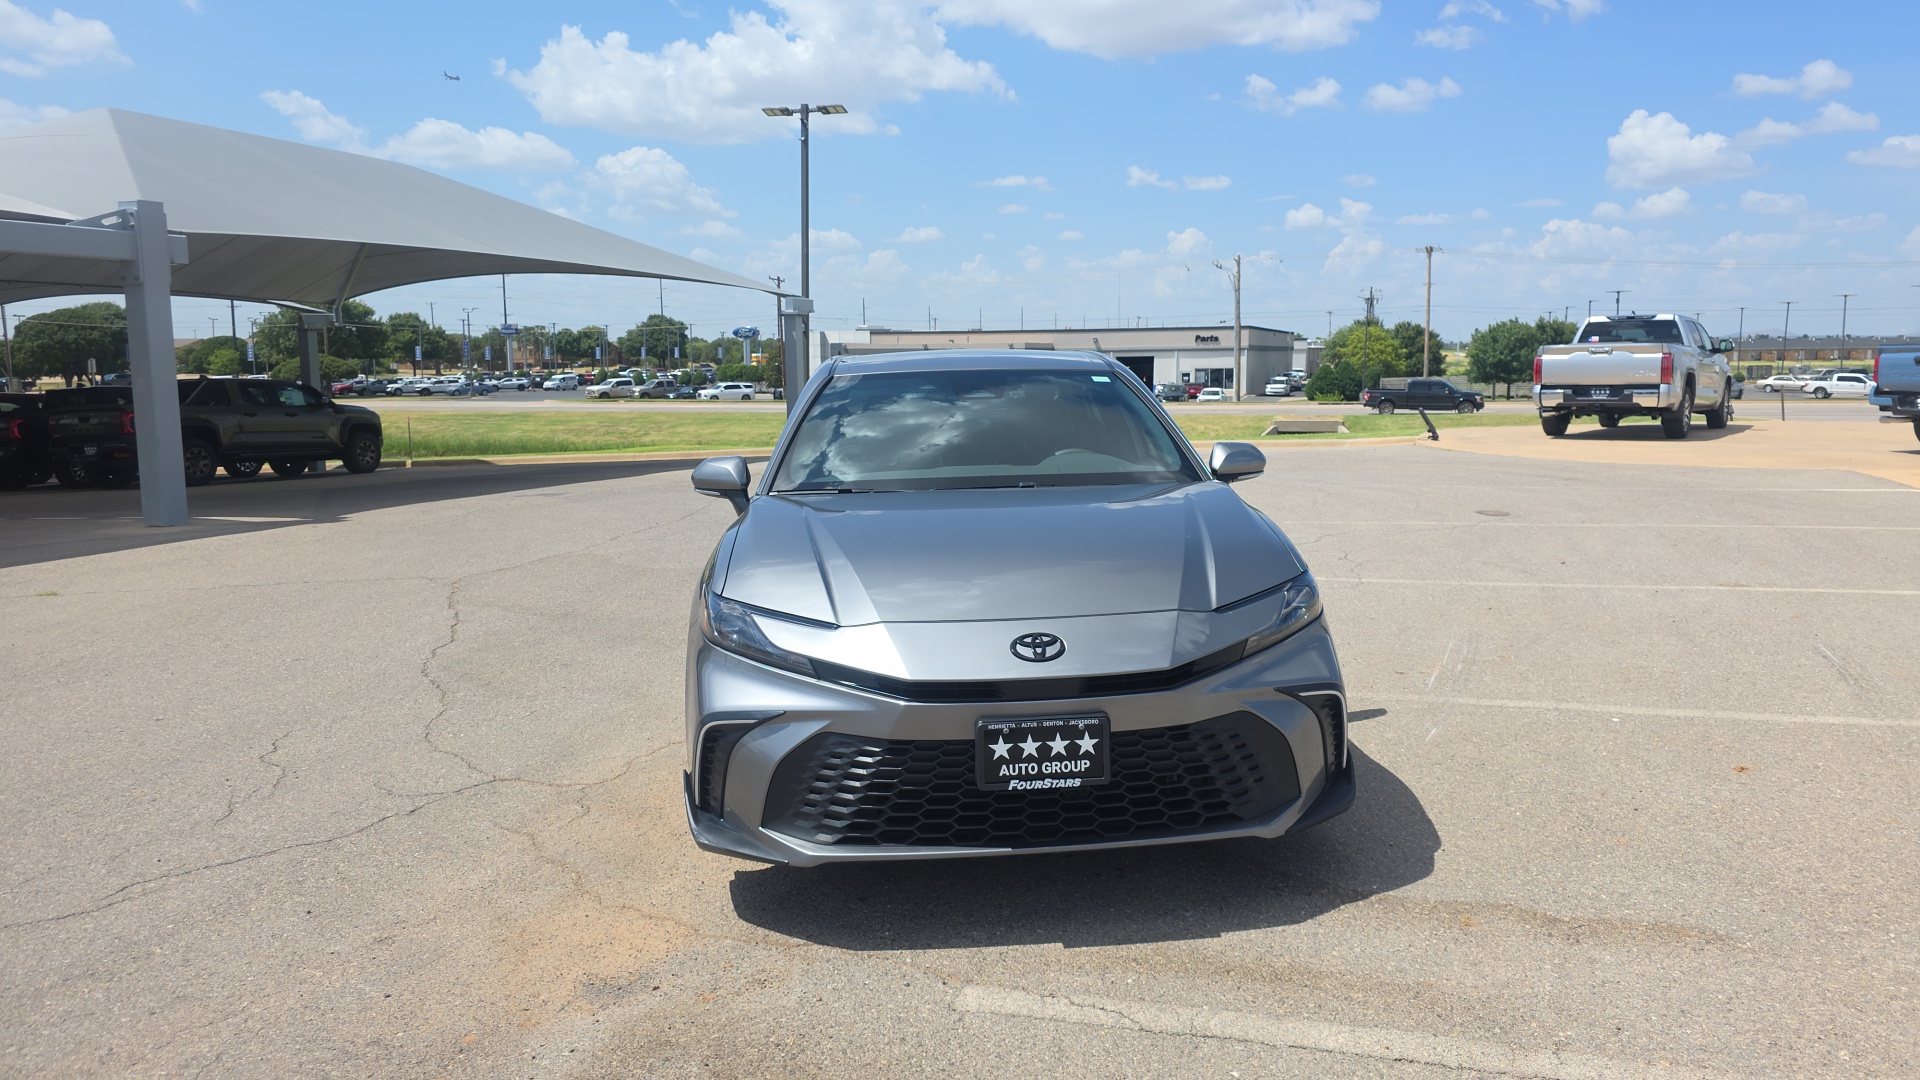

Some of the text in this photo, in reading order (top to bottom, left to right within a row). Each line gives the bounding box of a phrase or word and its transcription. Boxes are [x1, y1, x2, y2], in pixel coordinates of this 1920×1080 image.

[1195, 335, 1219, 343] Parts
[1068, 718, 1099, 726] JACKSBORO
[999, 760, 1091, 777] AUTO GROUP
[1008, 778, 1082, 791] FOURSTARS
